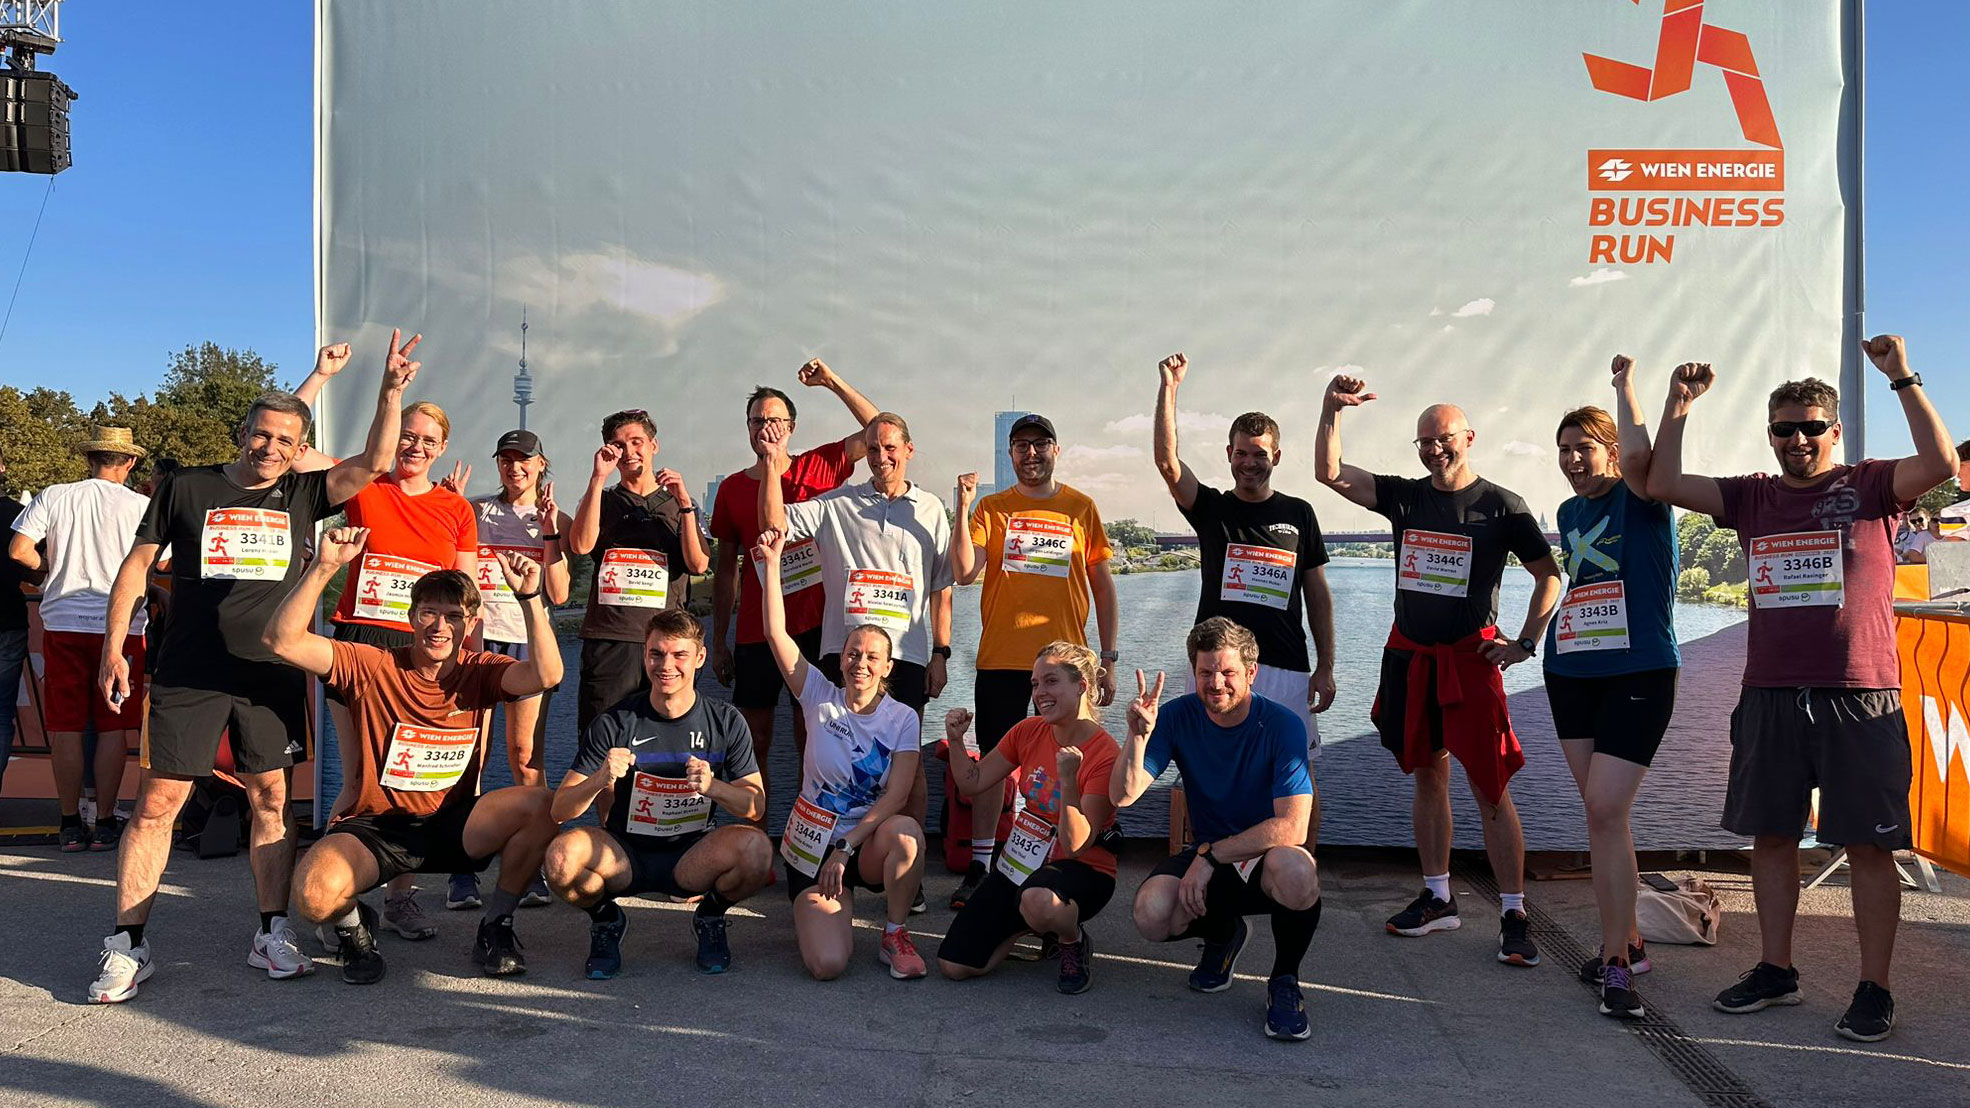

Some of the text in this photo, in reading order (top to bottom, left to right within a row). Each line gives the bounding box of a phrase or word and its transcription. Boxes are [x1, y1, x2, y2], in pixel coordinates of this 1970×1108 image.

[1641, 163, 1776, 178] WIEN ENERGIE
[1588, 197, 1785, 227] BUSINESS
[1588, 234, 1675, 264] RUN
[240, 532, 285, 546] 3341B
[1031, 537, 1067, 549] 3346C
[1439, 539, 1468, 547] ENERGIE
[1771, 537, 1835, 548] WIEN ENERGIE
[780, 547, 815, 567] 3341C
[1426, 553, 1464, 567] 3344C
[1783, 556, 1833, 571] 3346B
[626, 568, 662, 580] 3342C
[1252, 565, 1288, 580] 3346A
[390, 578, 415, 590] 334
[873, 589, 908, 602] 3341A
[1589, 587, 1620, 596] ENERGIE
[1580, 604, 1618, 618] 3343B
[419, 733, 473, 742] WIEN ENERGIE
[689, 731, 704, 749] 14
[424, 750, 465, 761] 3342B
[656, 782, 677, 790] WIEN
[664, 796, 705, 809] 3342A
[806, 808, 833, 825] ENERGIE
[795, 821, 822, 844] 3344A
[1011, 832, 1041, 856] 3343C
